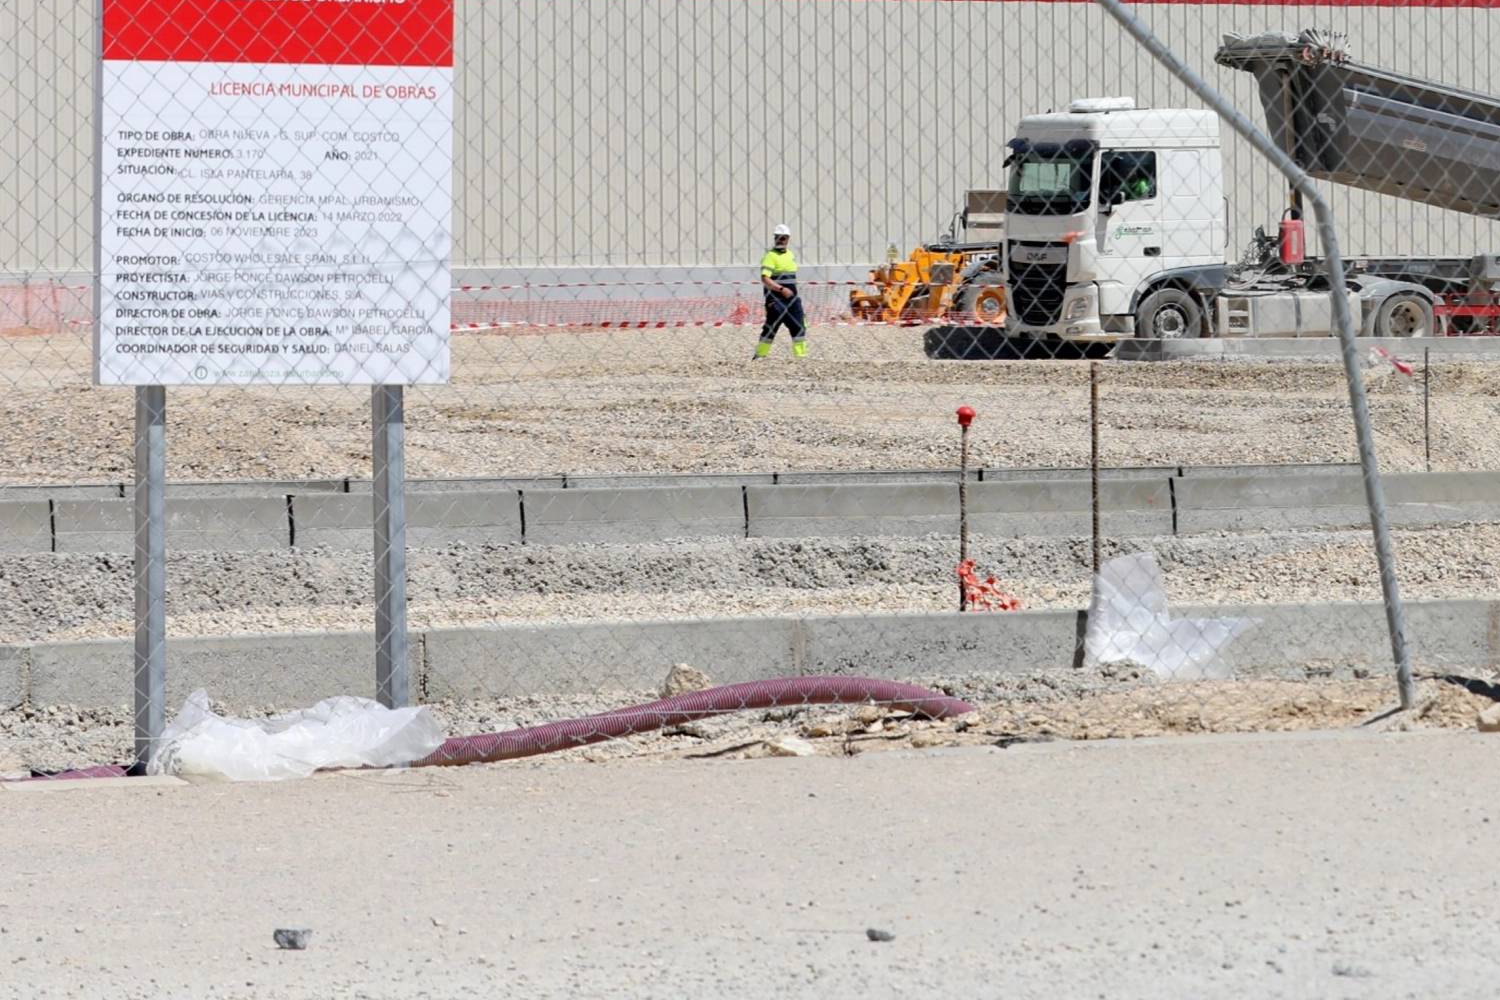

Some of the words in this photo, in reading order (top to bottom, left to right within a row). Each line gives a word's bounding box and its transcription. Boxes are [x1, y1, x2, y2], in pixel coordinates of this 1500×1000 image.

[211, 83, 275, 96] LICENCIA
[280, 84, 357, 98] MUNICIPAL
[363, 85, 381, 98] DE
[386, 86, 436, 99] OBRAS
[118, 132, 142, 140] TIPO
[145, 132, 159, 140] DE
[163, 132, 195, 141] OBRA:
[199, 130, 229, 139] OBRA
[233, 131, 270, 140] NUEVA
[354, 133, 399, 142] COSTCO
[118, 149, 180, 158] EXPEDIENTE
[324, 149, 351, 160] AÑO:
[355, 151, 378, 160] 2021
[300, 171, 312, 180] 38
[168, 194, 181, 203] DE
[259, 195, 315, 205] GERENCIA
[117, 211, 150, 220] FECHA
[154, 211, 167, 220] DE
[235, 212, 249, 221] DE
[252, 212, 264, 221] LA
[268, 212, 317, 221] LICENCIA:
[323, 212, 333, 221] 14
[337, 212, 375, 221] MARZO
[379, 213, 402, 222] 2022
[117, 228, 150, 237] FECHA
[154, 228, 167, 237] DE
[171, 228, 206, 237] INICIO:
[211, 228, 223, 236] 06
[226, 228, 290, 237] NOVIEMBRE
[294, 228, 317, 237] 2023
[116, 256, 180, 265] PROMOTOR:
[185, 253, 231, 263] COSTCO
[235, 254, 300, 264] WHOLESALE
[116, 273, 190, 283] PROYECTISTA:
[195, 273, 230, 282] JORGE
[235, 273, 271, 282] PONCE
[275, 273, 324, 283] DAWSON
[116, 291, 197, 300] CONSTRUCTOR:
[201, 290, 225, 298] VIAS
[116, 309, 168, 318] DIRECTOR
[171, 309, 184, 318] DE
[188, 310, 221, 318] OBRA:
[226, 308, 262, 318] JORGE
[266, 308, 304, 318] PONCE
[307, 309, 355, 318] DAWSON
[116, 327, 168, 336] DIRECTOR
[172, 327, 186, 336] DE
[189, 327, 202, 336] LA
[266, 327, 279, 336] DE
[283, 327, 296, 336] LA
[299, 328, 332, 336] OBRA:
[352, 326, 387, 335] ISABEL
[116, 344, 197, 353] COORDINADOR
[201, 344, 214, 353] DE
[218, 344, 279, 354] SEGURIDAD
[282, 345, 288, 353] Y
[292, 344, 330, 354] SALUD:
[334, 343, 372, 353] DANIEL
[375, 343, 410, 353] SALAS
